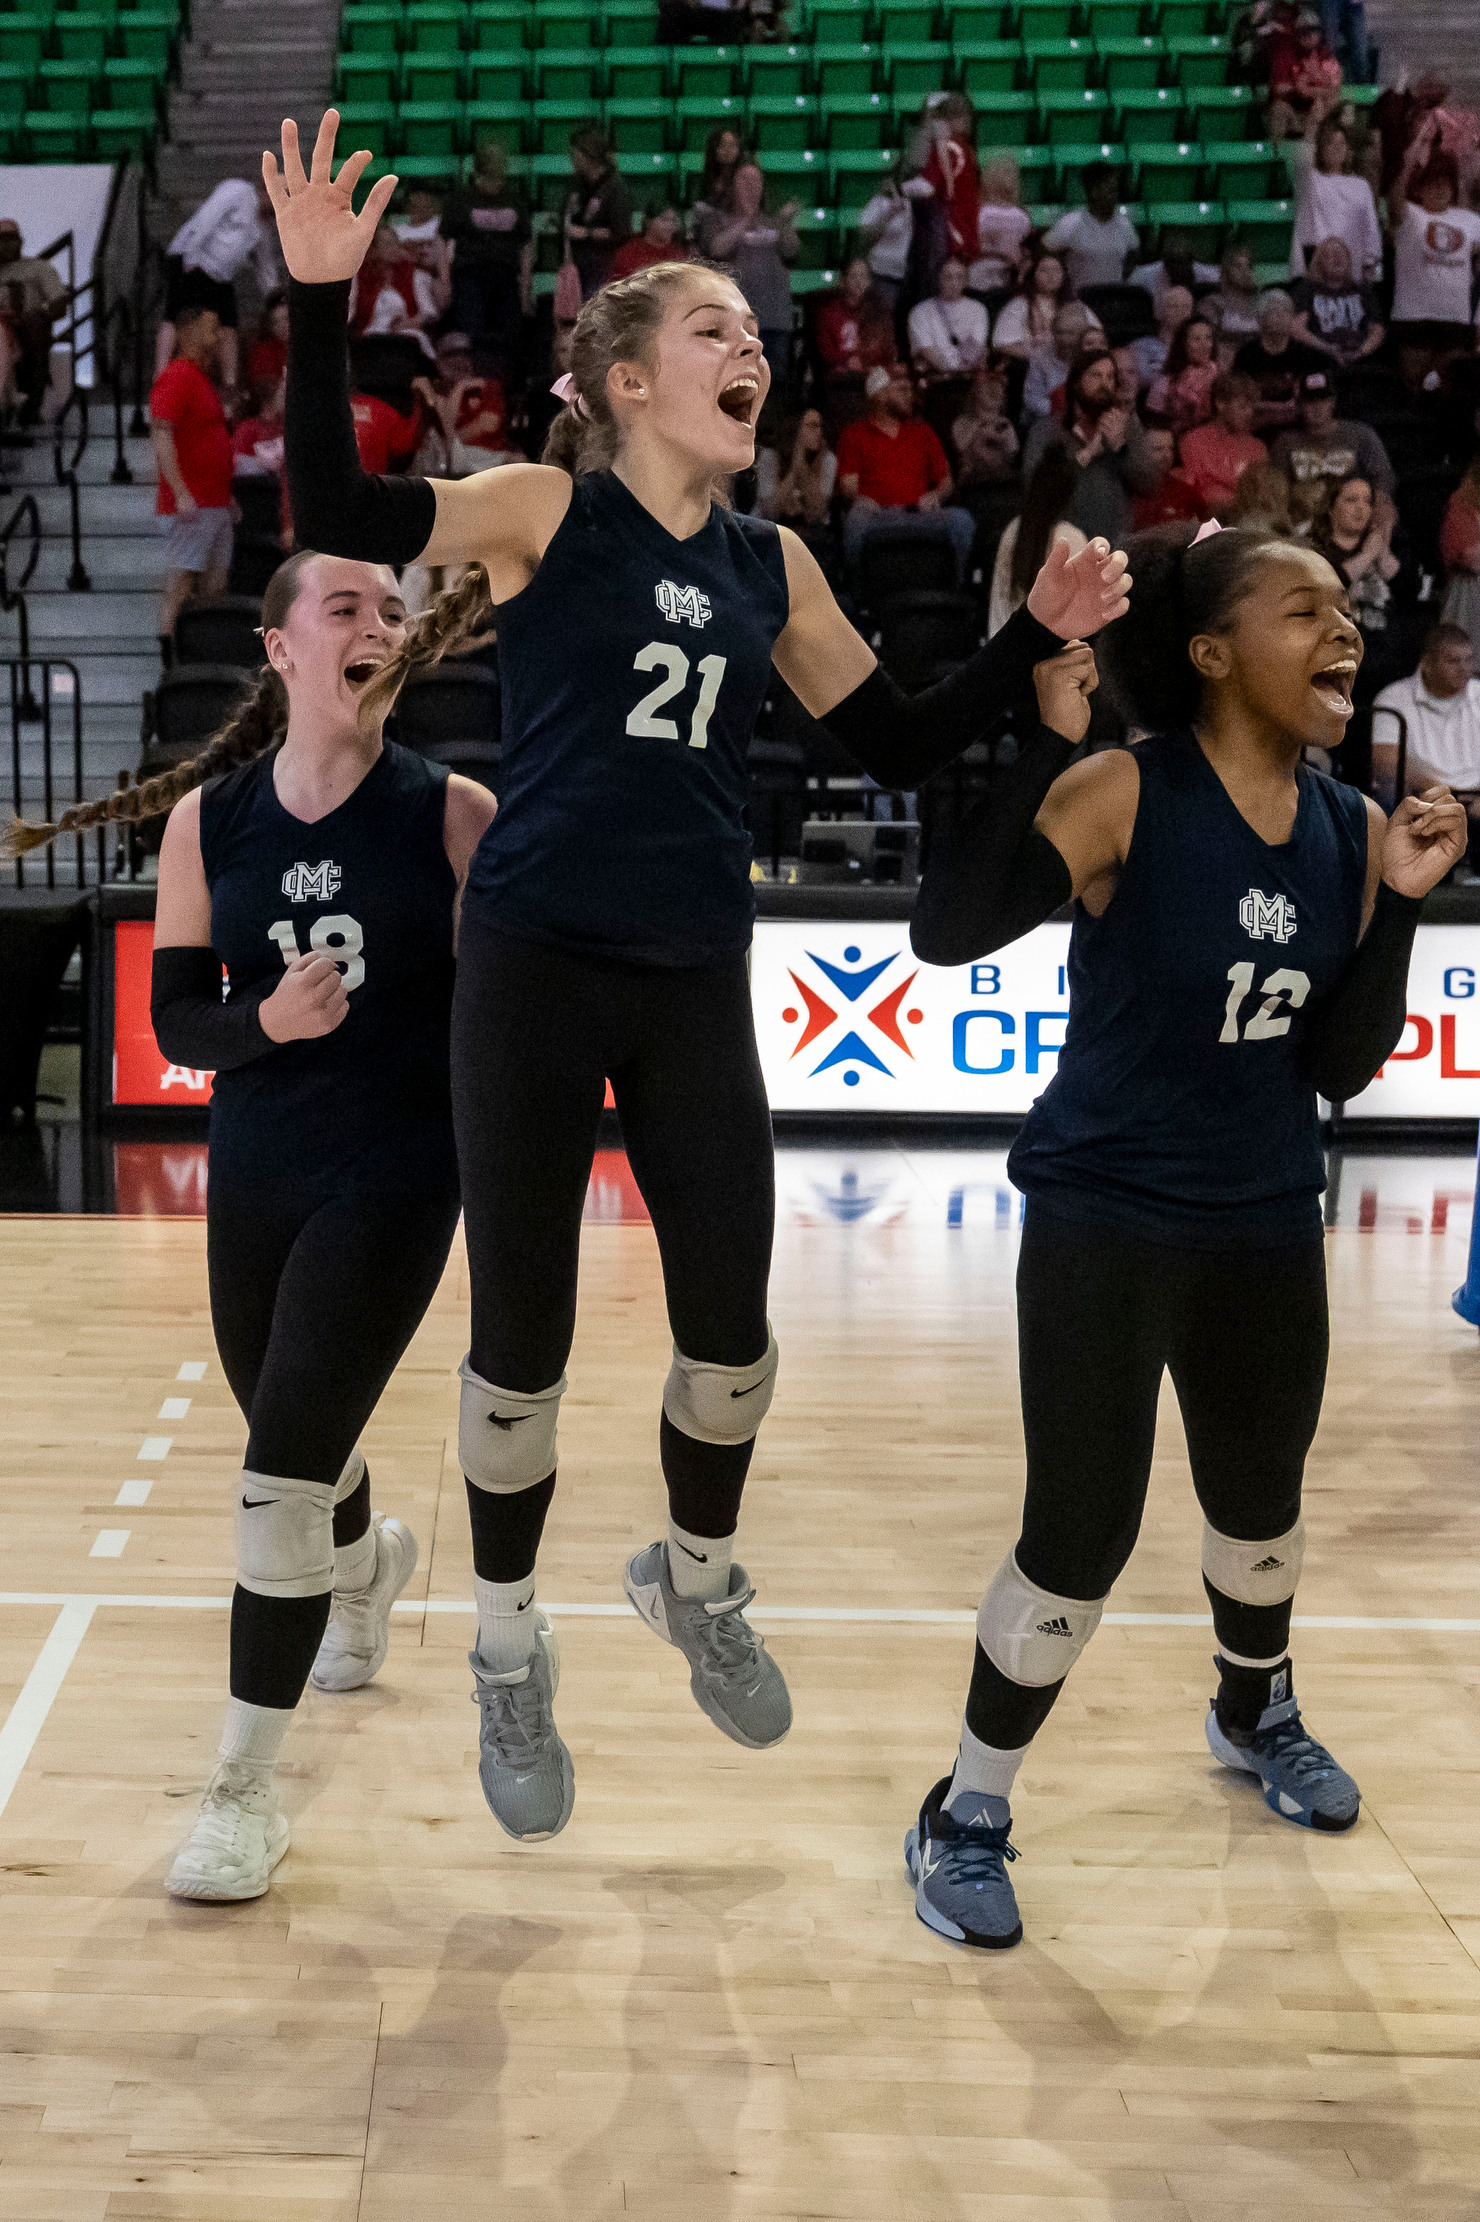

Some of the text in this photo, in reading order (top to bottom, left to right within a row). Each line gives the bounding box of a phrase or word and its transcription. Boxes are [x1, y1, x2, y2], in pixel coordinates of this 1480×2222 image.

[625, 641, 727, 749] 21
[267, 914, 366, 993] 18
[1218, 961, 1311, 1043] 12
[1249, 1561, 1286, 1572] adidas
[1036, 1624, 1074, 1638] adidas
